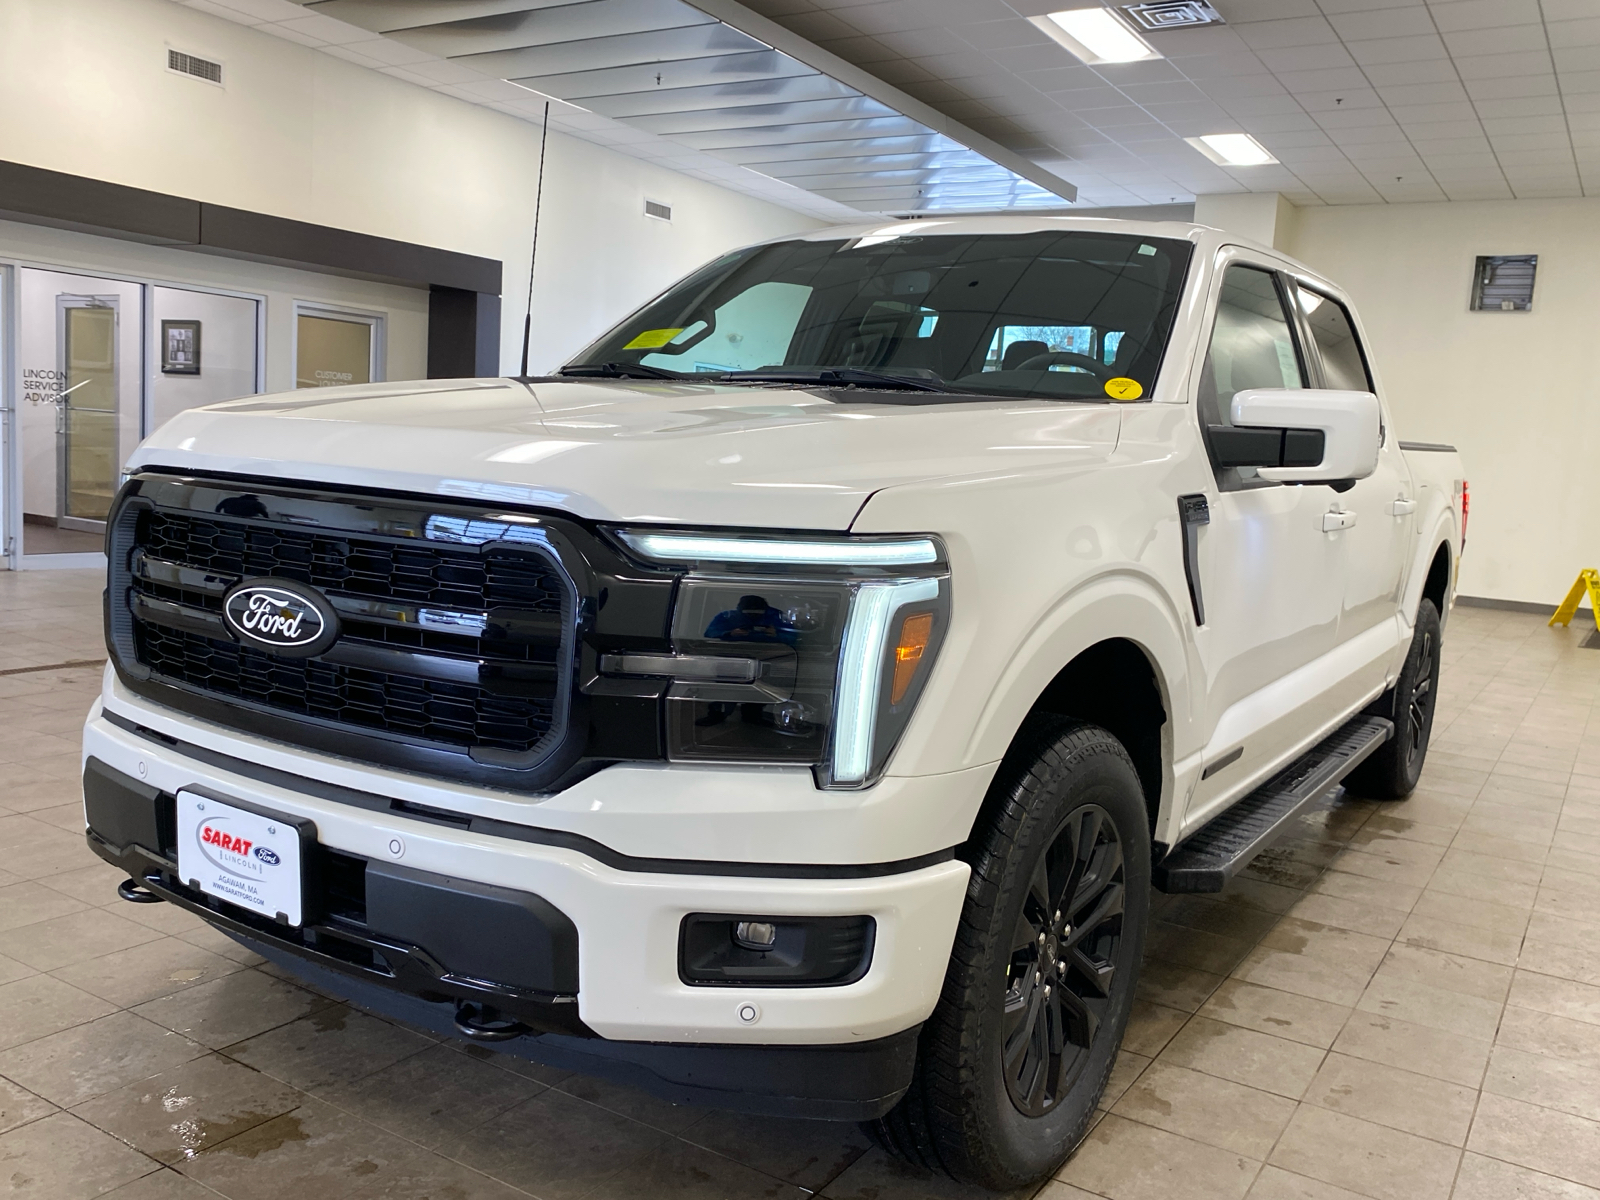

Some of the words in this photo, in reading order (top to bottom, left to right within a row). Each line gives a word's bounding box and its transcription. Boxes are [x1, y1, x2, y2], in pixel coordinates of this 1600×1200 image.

[23, 369, 68, 380] LINCOLN
[315, 370, 352, 381] CUSTOMER
[23, 380, 64, 392] SERVICE
[24, 392, 70, 404] ADVISOR
[242, 594, 304, 639] Ford
[202, 826, 252, 857] SARAT
[224, 853, 257, 871] LINCOLN
[258, 848, 277, 864] Ford
[218, 874, 247, 892] AGAWAM,
[248, 884, 258, 895] MA
[212, 881, 265, 906] WWW.SARATFORD.COM
